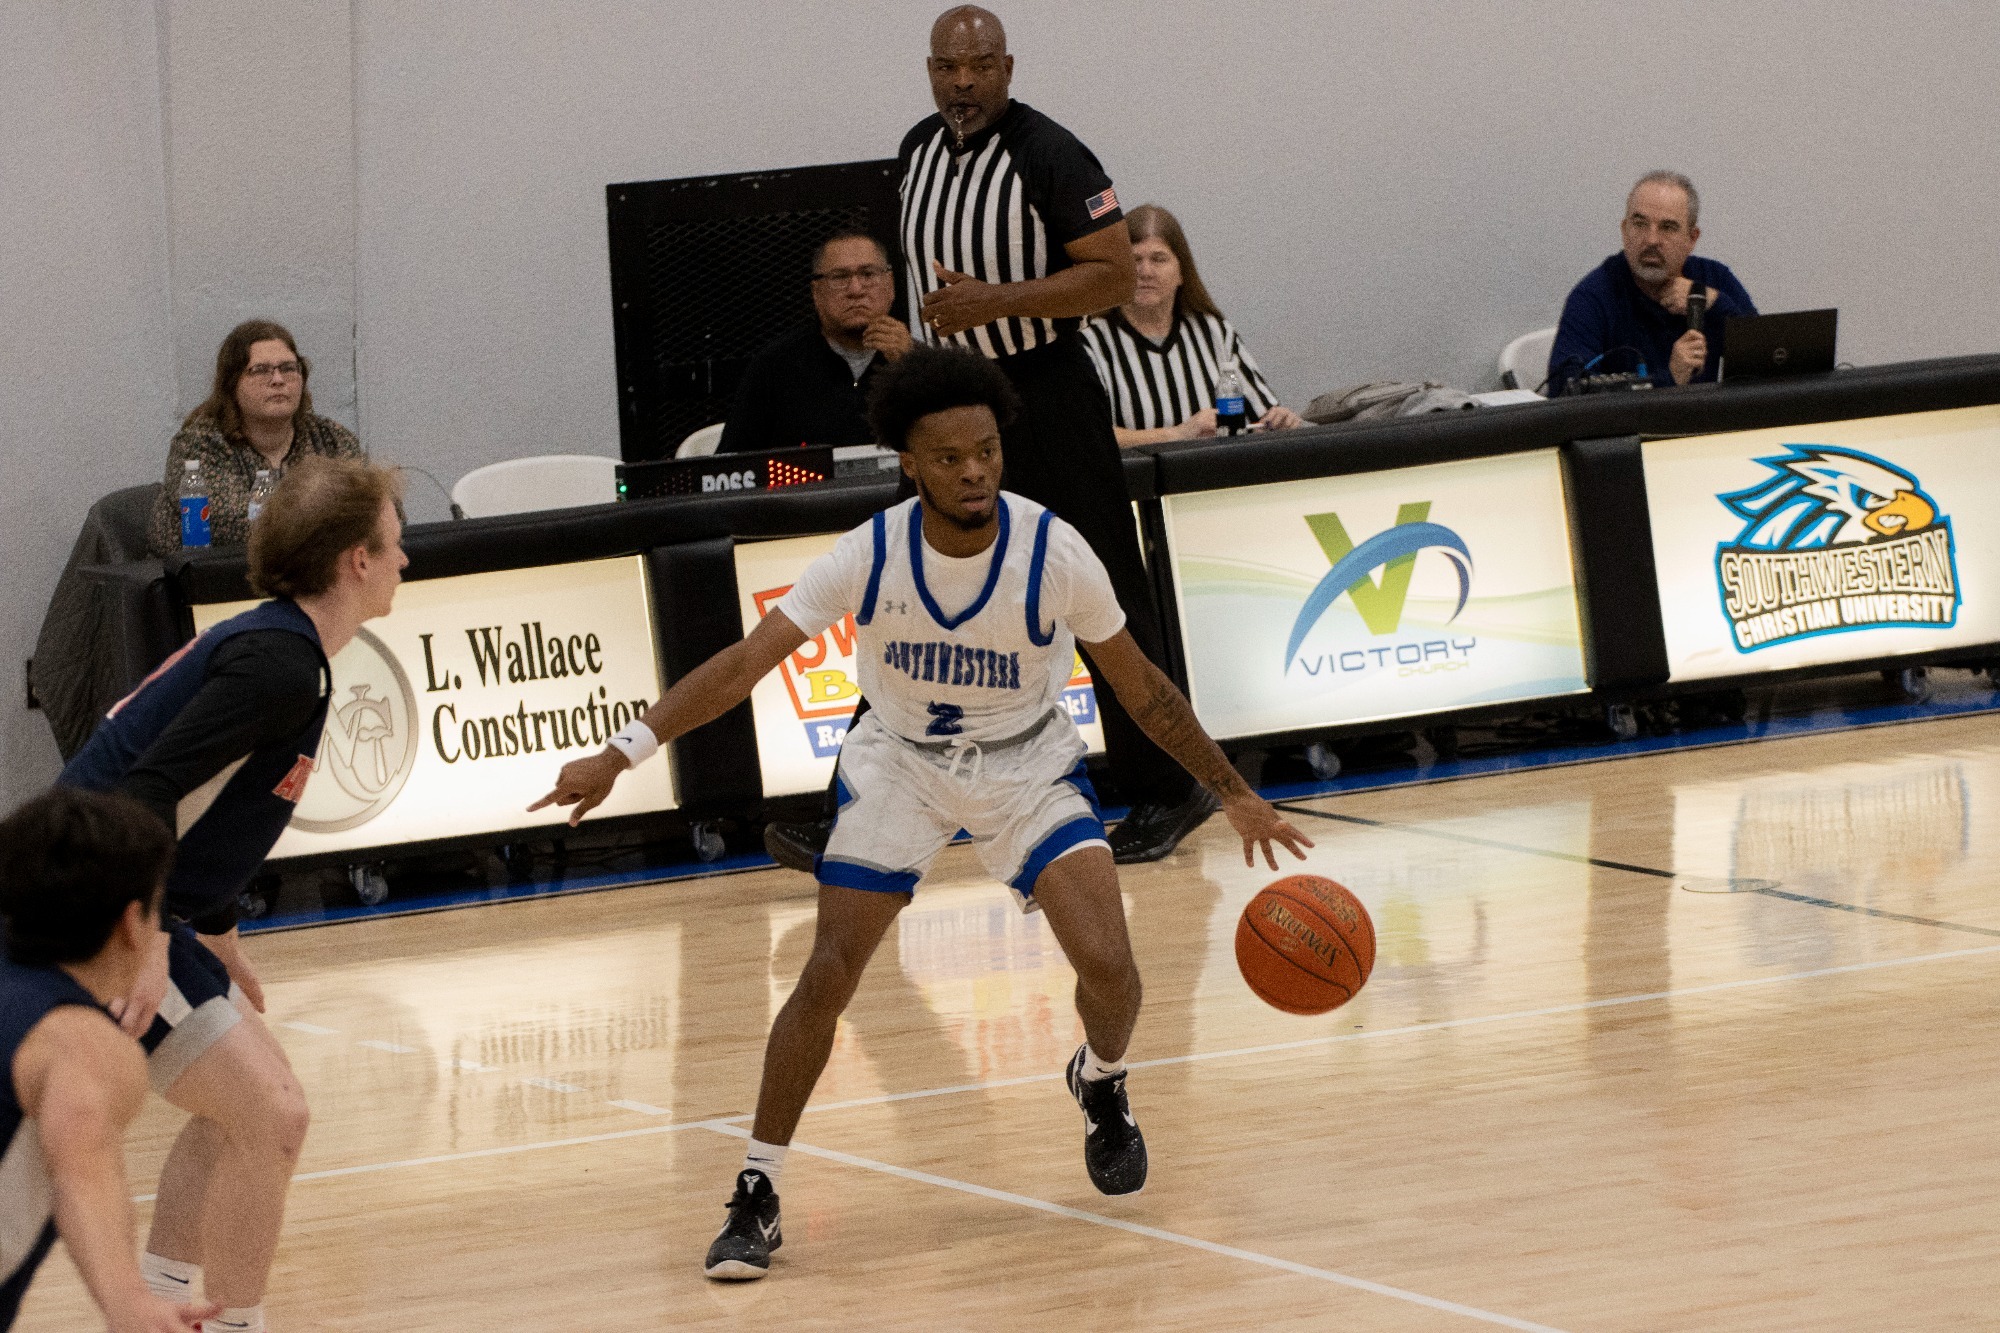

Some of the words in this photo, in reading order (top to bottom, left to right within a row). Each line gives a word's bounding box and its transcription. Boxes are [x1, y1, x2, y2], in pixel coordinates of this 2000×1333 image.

[1721, 529, 1954, 617] SOUTHWESTERN
[1735, 609, 1840, 648] CHRISTIAN
[1841, 594, 1955, 623] UNIVERSITY
[420, 634, 462, 692] L.
[467, 622, 603, 687] Wallace
[1301, 637, 1475, 675] VICTORY
[1398, 661, 1469, 677] CHURCH
[925, 700, 964, 736] 2
[1260, 899, 1342, 967] SPALDING
